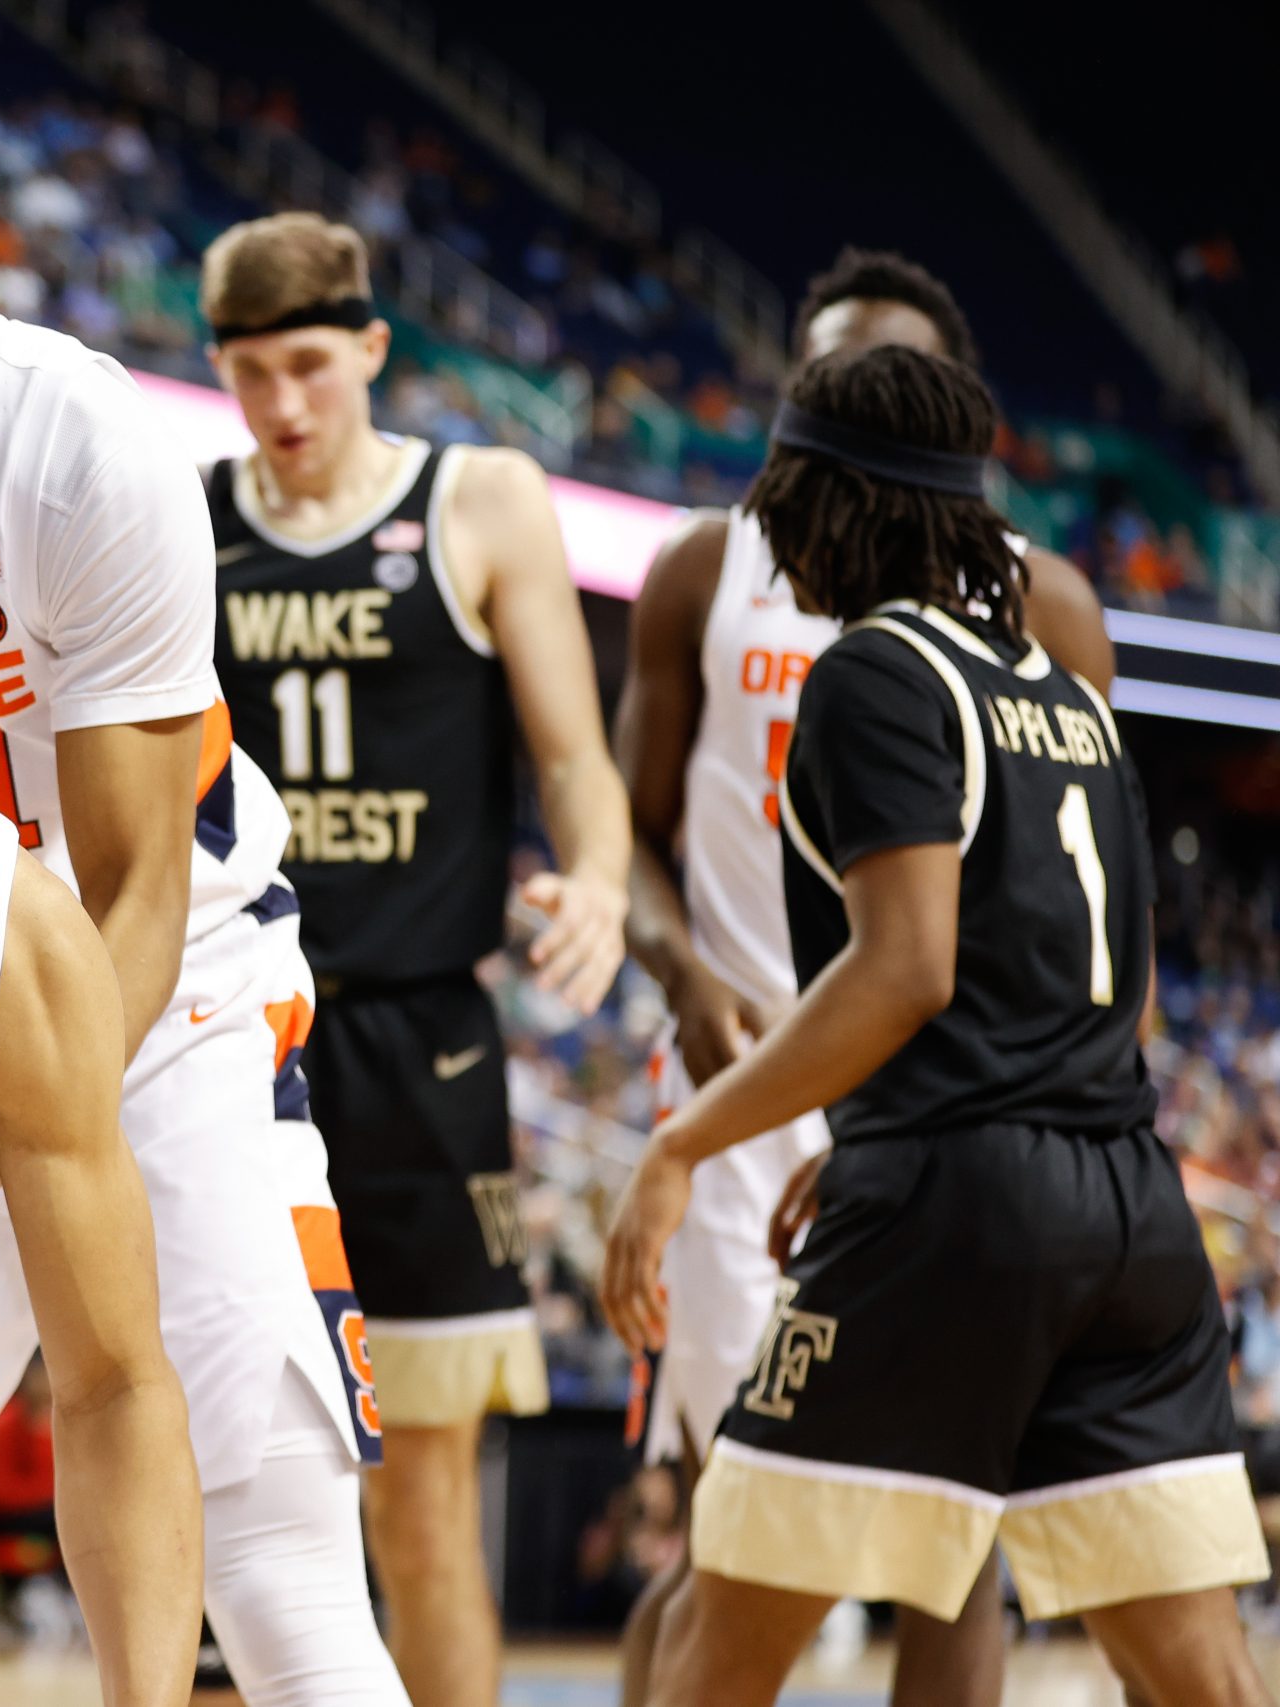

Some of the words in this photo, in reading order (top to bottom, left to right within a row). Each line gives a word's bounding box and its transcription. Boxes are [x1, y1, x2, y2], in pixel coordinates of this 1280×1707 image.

[225, 588, 394, 663] WAKE
[272, 667, 354, 782] 11
[282, 789, 429, 864] REST
[1057, 783, 1114, 1006] 1
